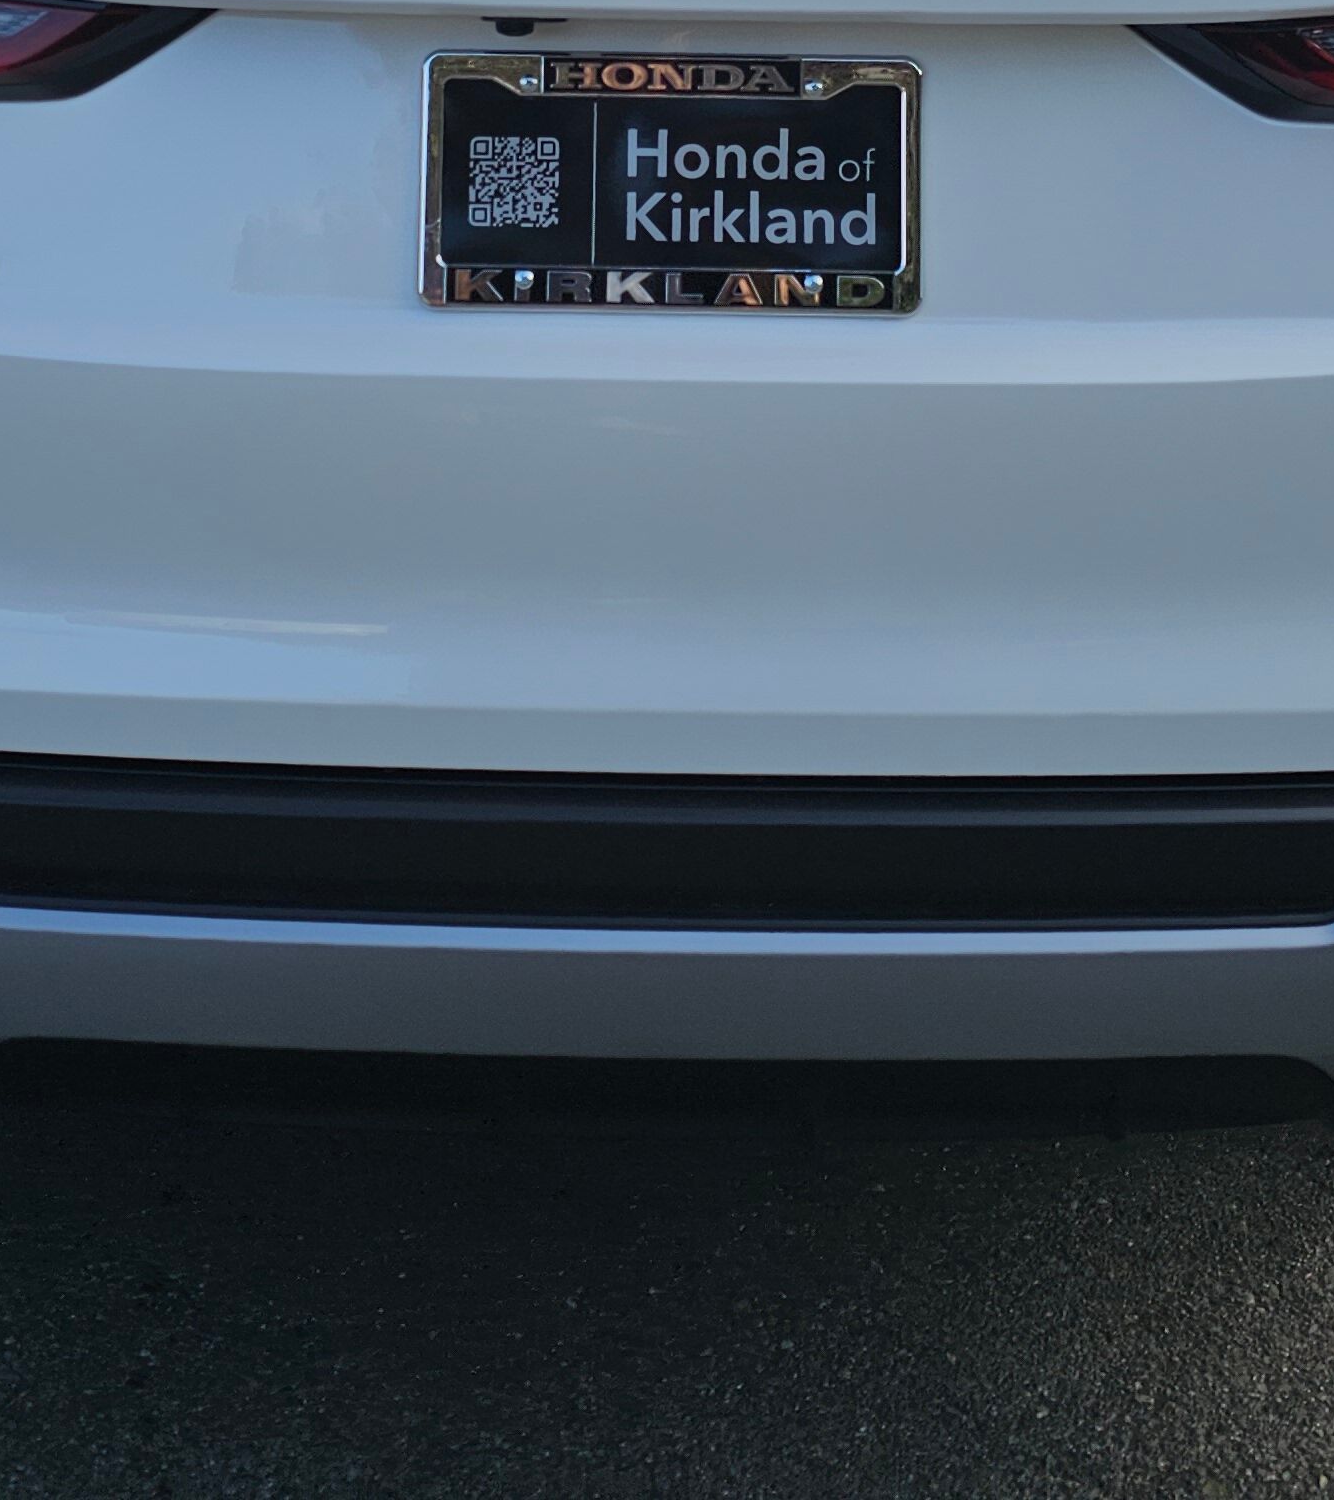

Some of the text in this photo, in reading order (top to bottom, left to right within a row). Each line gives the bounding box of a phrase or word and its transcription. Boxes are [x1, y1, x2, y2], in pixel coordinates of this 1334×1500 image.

[549, 62, 795, 92] HONDA
[625, 127, 877, 183] Honda of
[625, 190, 877, 246] Kirkland
